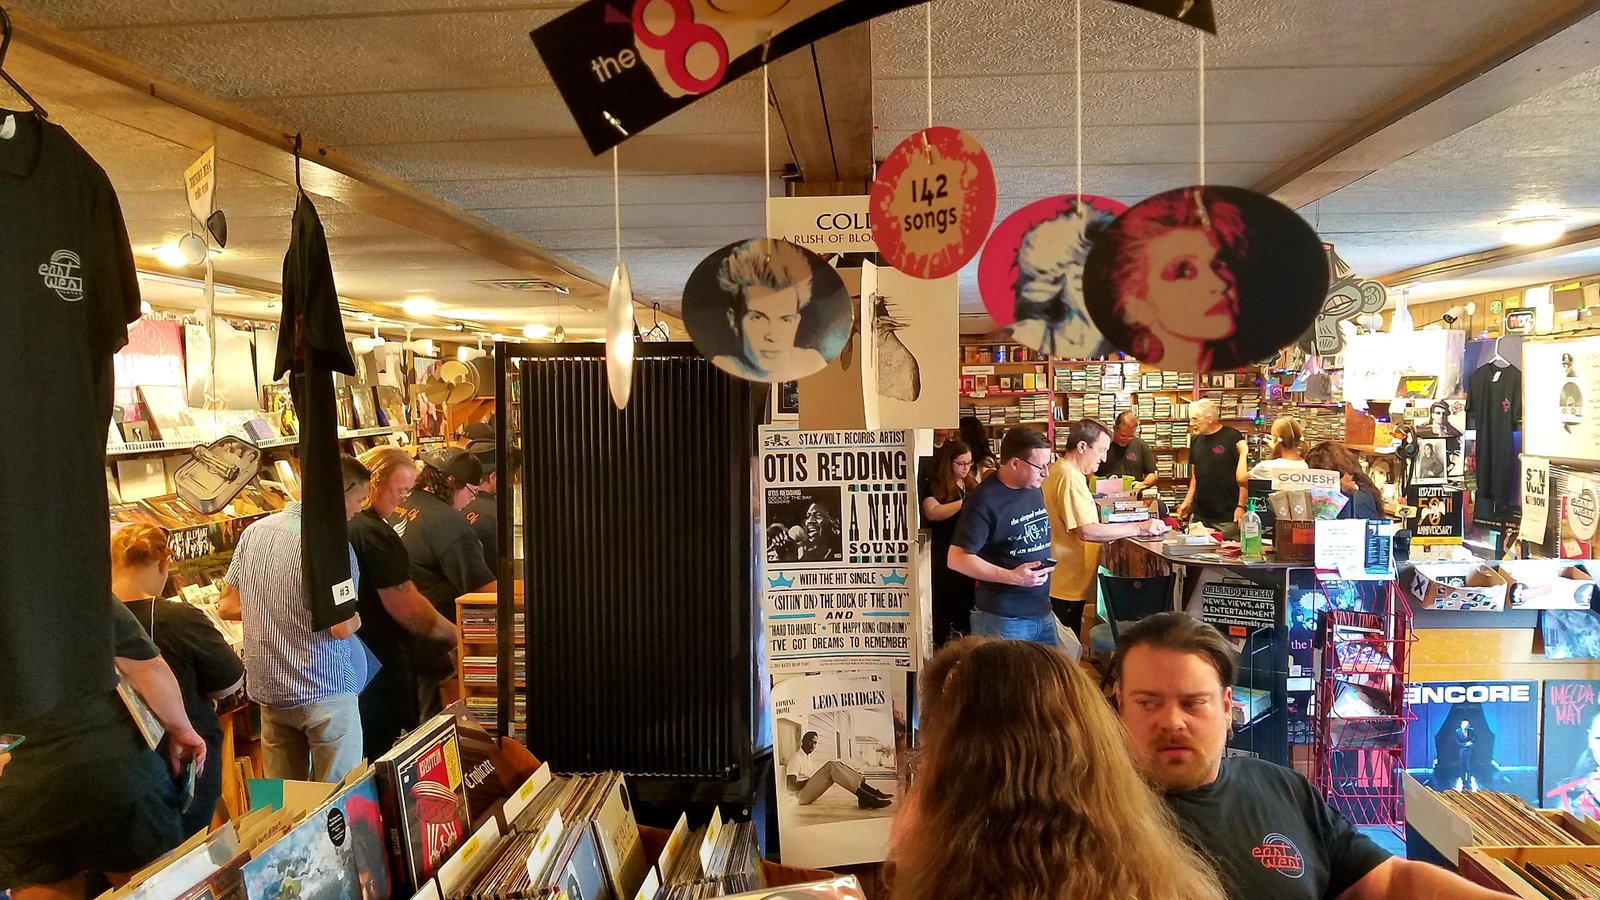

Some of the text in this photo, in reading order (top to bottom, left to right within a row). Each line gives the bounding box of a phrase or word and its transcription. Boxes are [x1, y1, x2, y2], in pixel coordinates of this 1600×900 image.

[591, 48, 637, 83] the
[911, 174, 949, 207] 142
[816, 213, 872, 230] COL
[904, 206, 957, 234] songs
[794, 235, 824, 244] RUSH
[828, 234, 844, 243] OF
[798, 432, 841, 445] STAX/VOLT
[844, 431, 876, 444] RECORDS
[879, 430, 906, 444] ARTIST
[764, 450, 907, 482] OTIS REDDING
[1278, 473, 1336, 485] GONESH
[768, 489, 779, 497] OTIS
[849, 493, 908, 541] A NEW
[849, 542, 909, 555] SOUND
[799, 572, 876, 586] WITH THE HIT SINGLE
[339, 585, 350, 598] #3
[804, 594, 818, 610] ON)
[819, 593, 834, 609] THE
[836, 593, 857, 608] DOCK
[858, 593, 867, 608] OF
[870, 593, 885, 608] THE
[1203, 598, 1227, 606] NEWS,
[1228, 600, 1254, 609] VIEWS,
[825, 611, 854, 620] AND
[1210, 606, 1274, 618] ENTERTAINMENT
[787, 624, 795, 636] TO
[842, 622, 861, 634] HAPPY
[861, 622, 876, 634] SONG
[792, 638, 807, 650] GOT
[812, 637, 845, 649] DREAMS
[850, 637, 859, 648] TO
[1291, 640, 1308, 650] the
[812, 690, 886, 710] LEON BRIDGES
[1551, 684, 1594, 705] IMELDA
[1555, 703, 1586, 726] MAY
